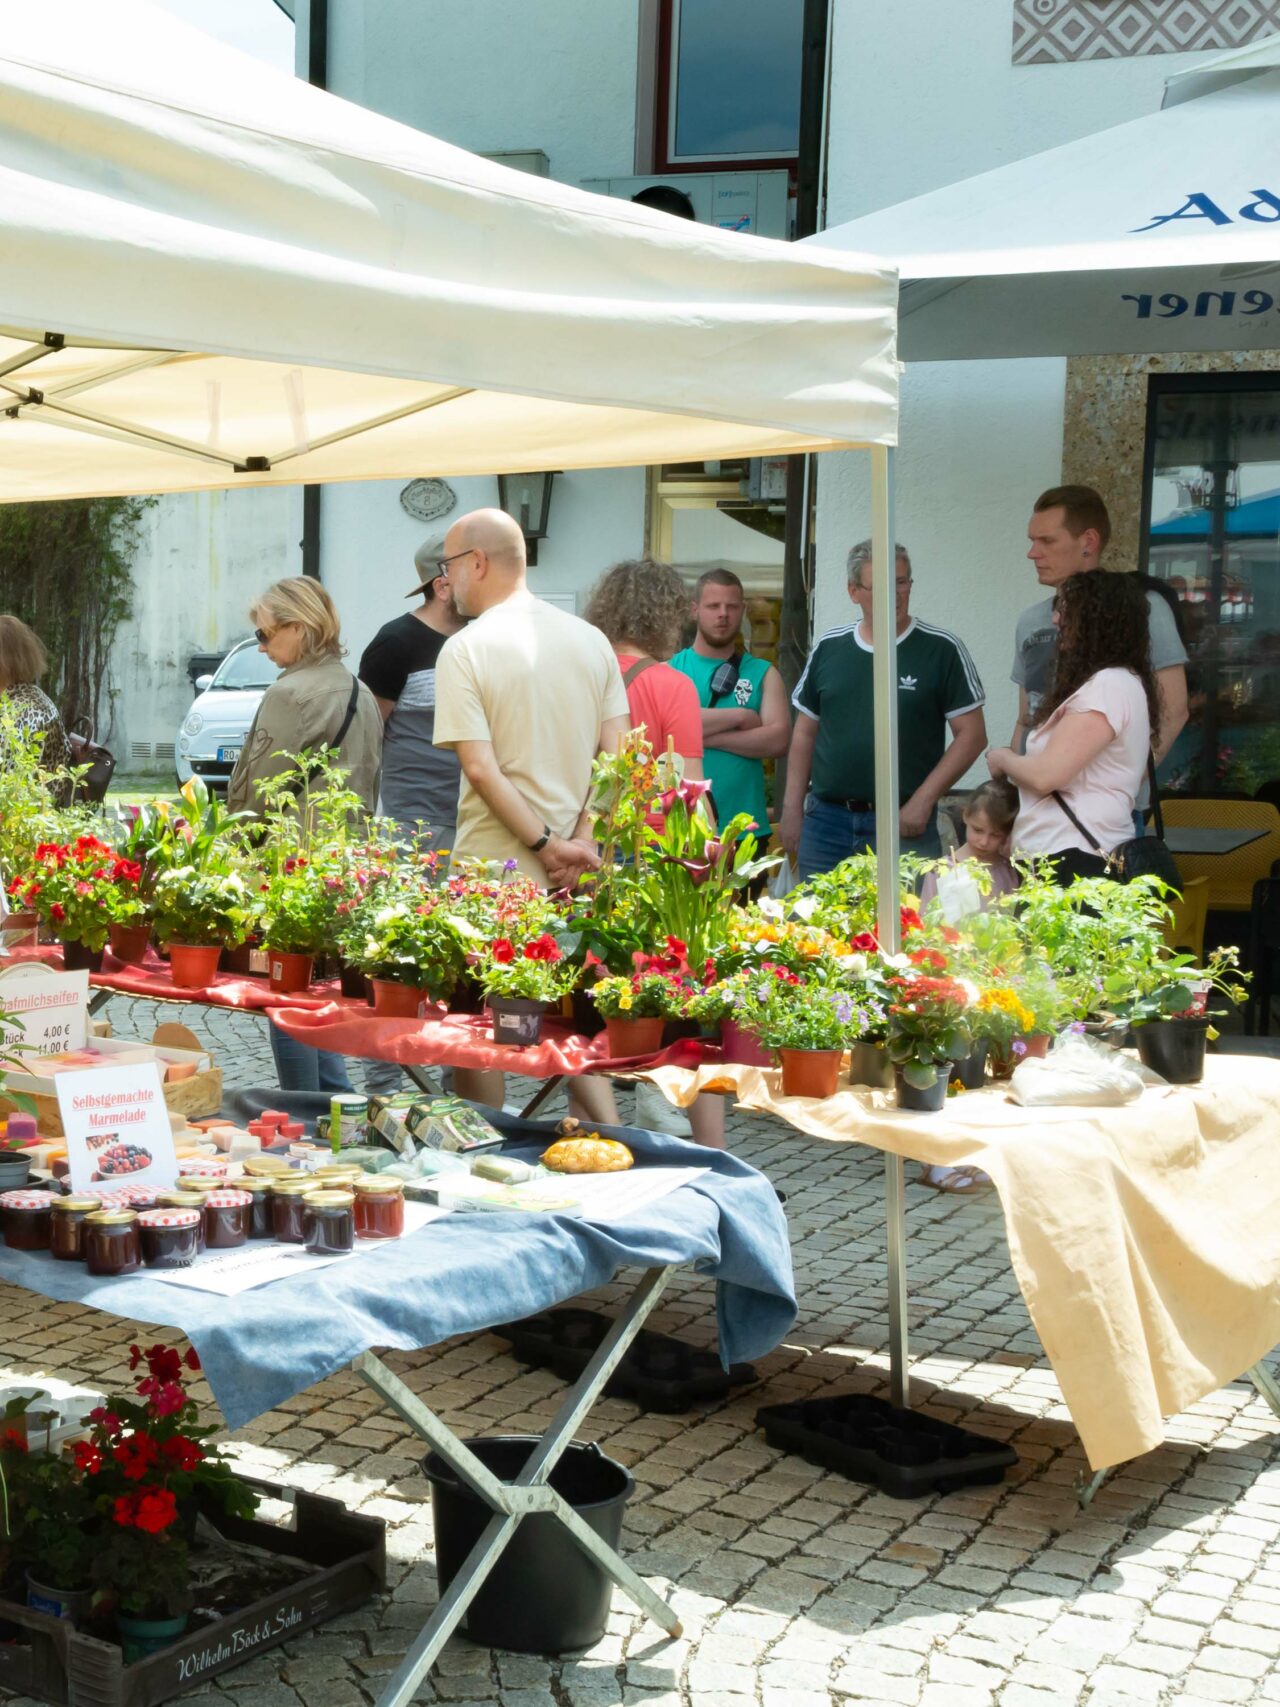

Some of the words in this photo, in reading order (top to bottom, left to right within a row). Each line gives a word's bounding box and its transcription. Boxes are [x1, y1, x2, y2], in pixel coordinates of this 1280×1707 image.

[0, 1031, 25, 1045] tück
[43, 1025, 62, 1039] 4,00
[64, 1023, 71, 1036] €
[63, 1040, 69, 1051] €
[71, 1088, 154, 1109] Selbstgemachte
[88, 1108, 147, 1127] Marmelade
[176, 1643, 231, 1681] Wilhelm
[231, 1624, 261, 1655] Böck
[261, 1620, 270, 1640] &
[271, 1605, 303, 1635] Sohn
